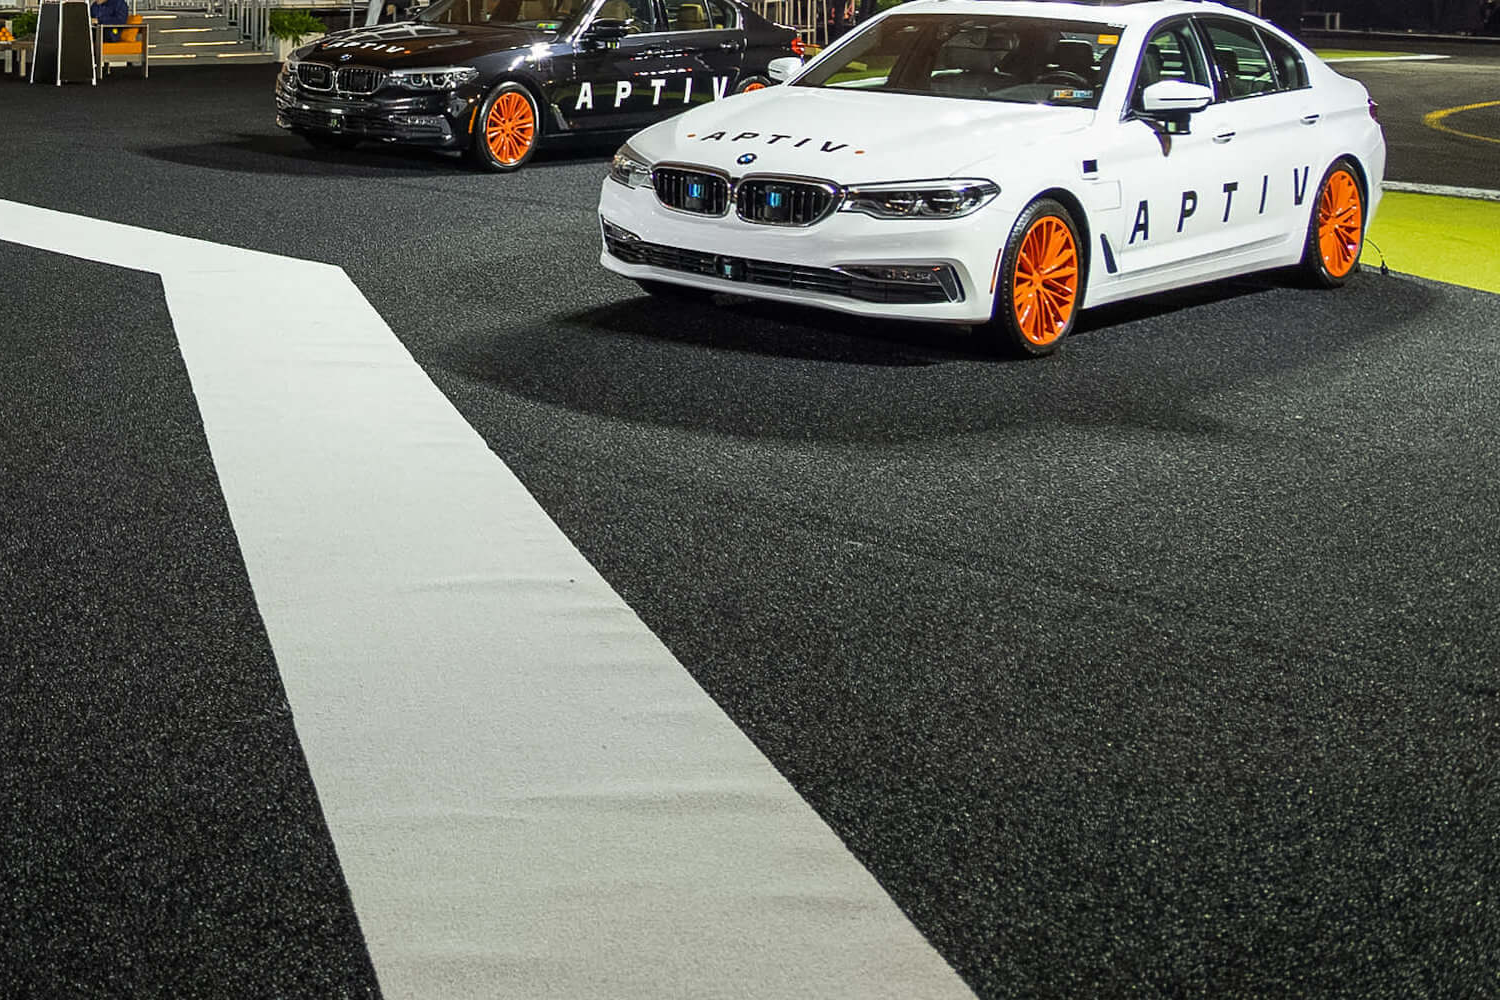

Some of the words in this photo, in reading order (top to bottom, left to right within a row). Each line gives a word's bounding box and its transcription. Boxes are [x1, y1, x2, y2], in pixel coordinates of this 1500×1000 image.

[574, 76, 728, 111] APTIV
[701, 131, 849, 153] APTIV
[1128, 166, 1309, 245] APTIV
